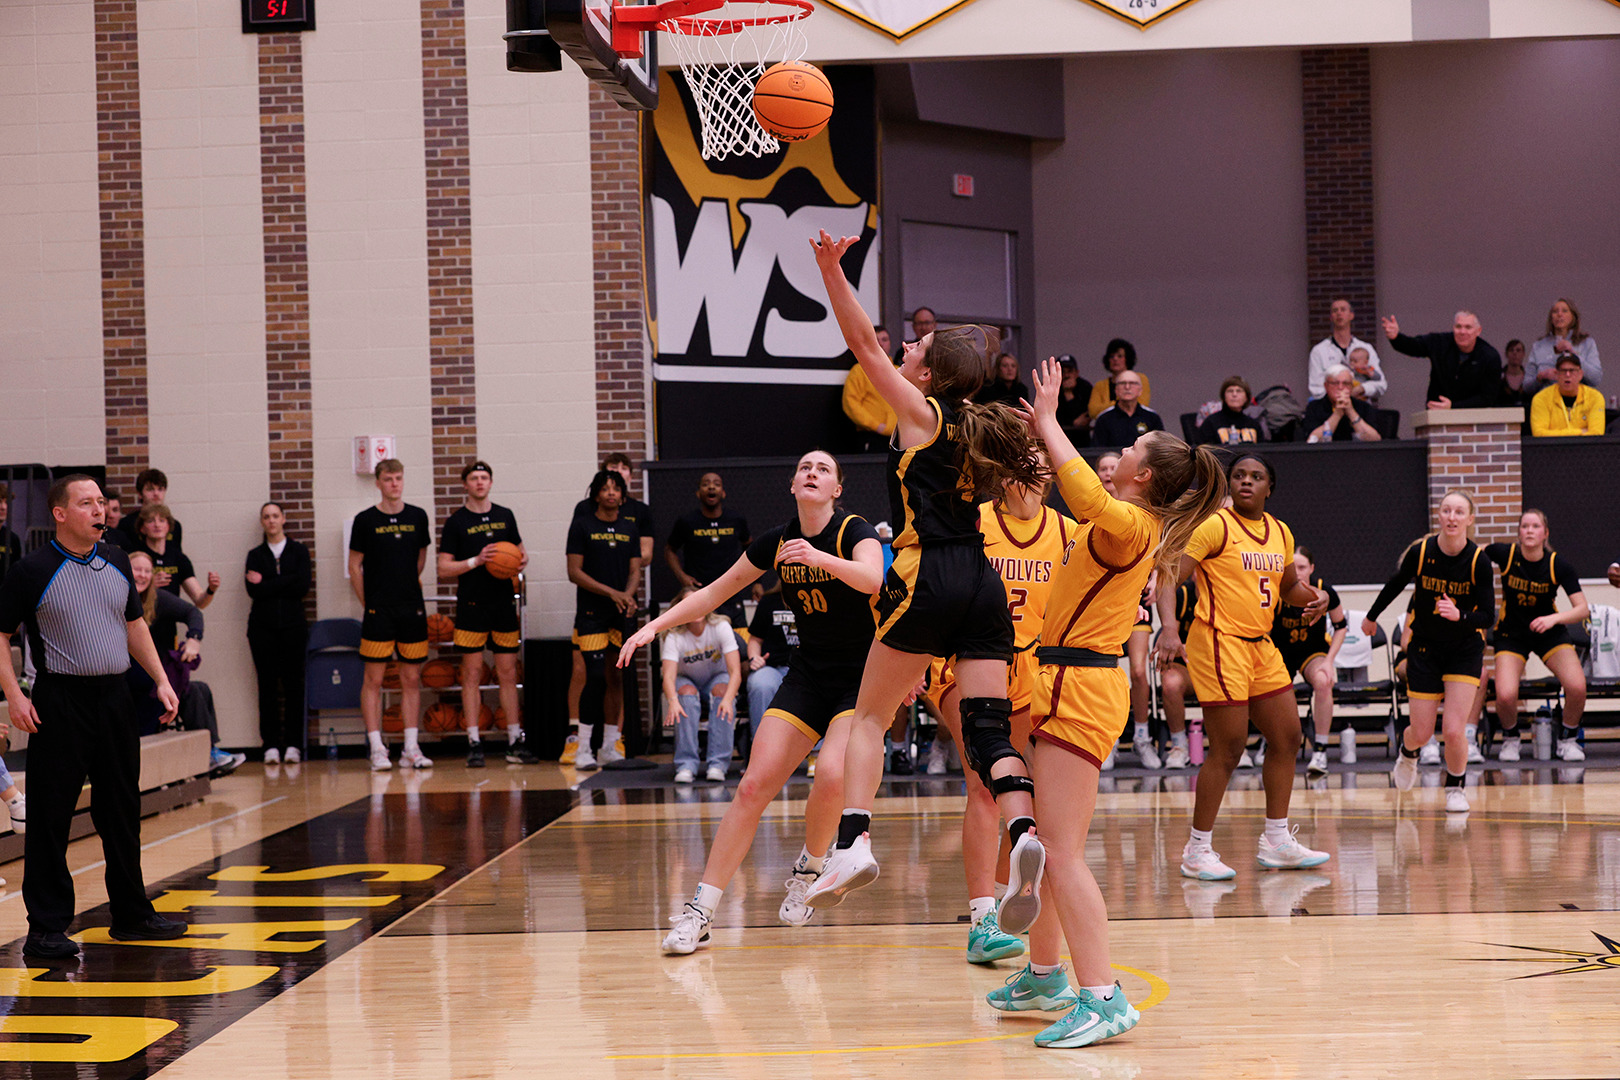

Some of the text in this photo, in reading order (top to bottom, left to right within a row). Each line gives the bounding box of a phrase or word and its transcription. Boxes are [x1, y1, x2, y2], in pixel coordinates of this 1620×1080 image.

[989, 557, 1052, 582] WOLVES
[1241, 551, 1284, 572] WOLVES
[1259, 576, 1272, 608] 5
[1421, 575, 1470, 595] WAYNE STATE
[797, 588, 828, 615] 30
